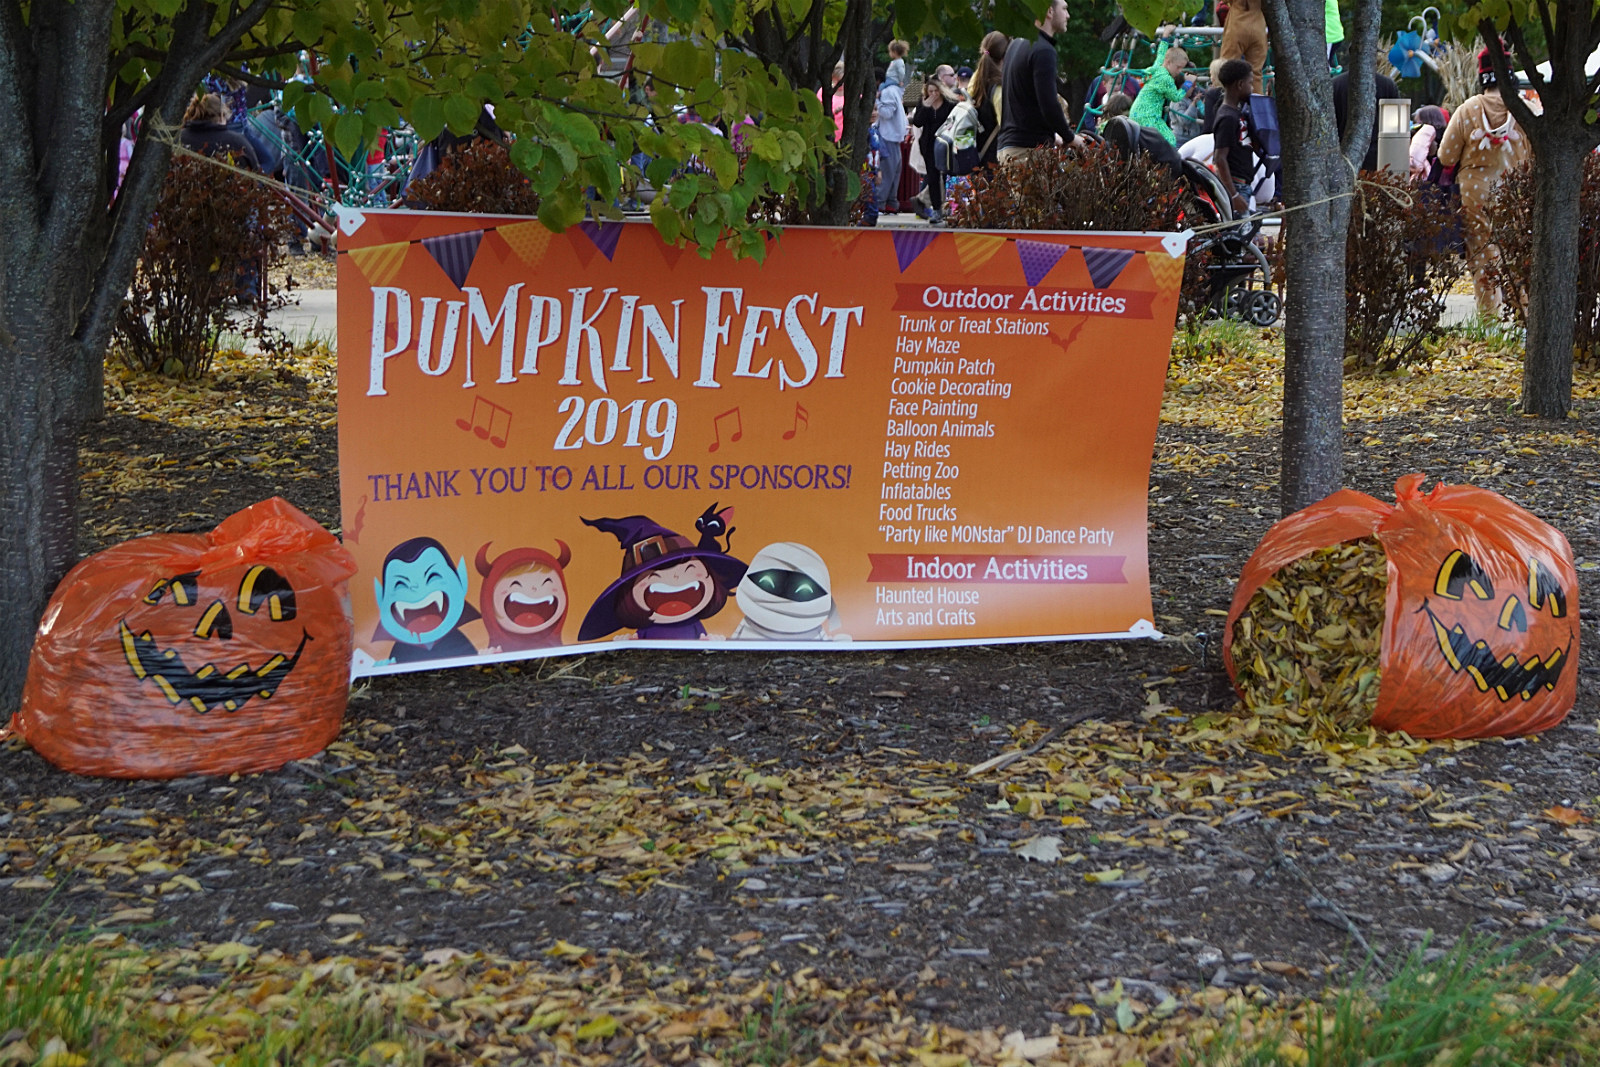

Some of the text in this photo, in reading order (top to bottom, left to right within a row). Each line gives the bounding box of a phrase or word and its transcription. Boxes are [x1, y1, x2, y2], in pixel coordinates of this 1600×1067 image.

[922, 285, 1127, 314] Outdoor Activities
[899, 315, 1049, 336] Trunk or Treat Stations
[366, 282, 865, 397] PUMPKIN FEST
[896, 336, 960, 355] Hay Maze
[893, 357, 996, 377] Pumpkin Patch
[891, 377, 1012, 399] Cookie Decorating
[888, 399, 978, 418] Face Painting
[553, 396, 678, 461] 2019
[886, 420, 995, 438] Balloon Animals
[884, 440, 951, 458] Hay Rides
[882, 462, 960, 480] Petting Zoo
[368, 464, 853, 502] THANK YOU TO ALL OUR SPONSORS!
[881, 482, 952, 500] Inflatables
[879, 503, 957, 521] Food Trucks
[924, 525, 948, 543] like
[1017, 526, 1034, 545] DJ
[1036, 526, 1076, 545] Dance
[1079, 526, 1115, 547] Party
[906, 556, 1089, 581] Indoor Activities
[876, 586, 980, 605] Haunted House
[875, 608, 977, 627] Arts and Crafts
